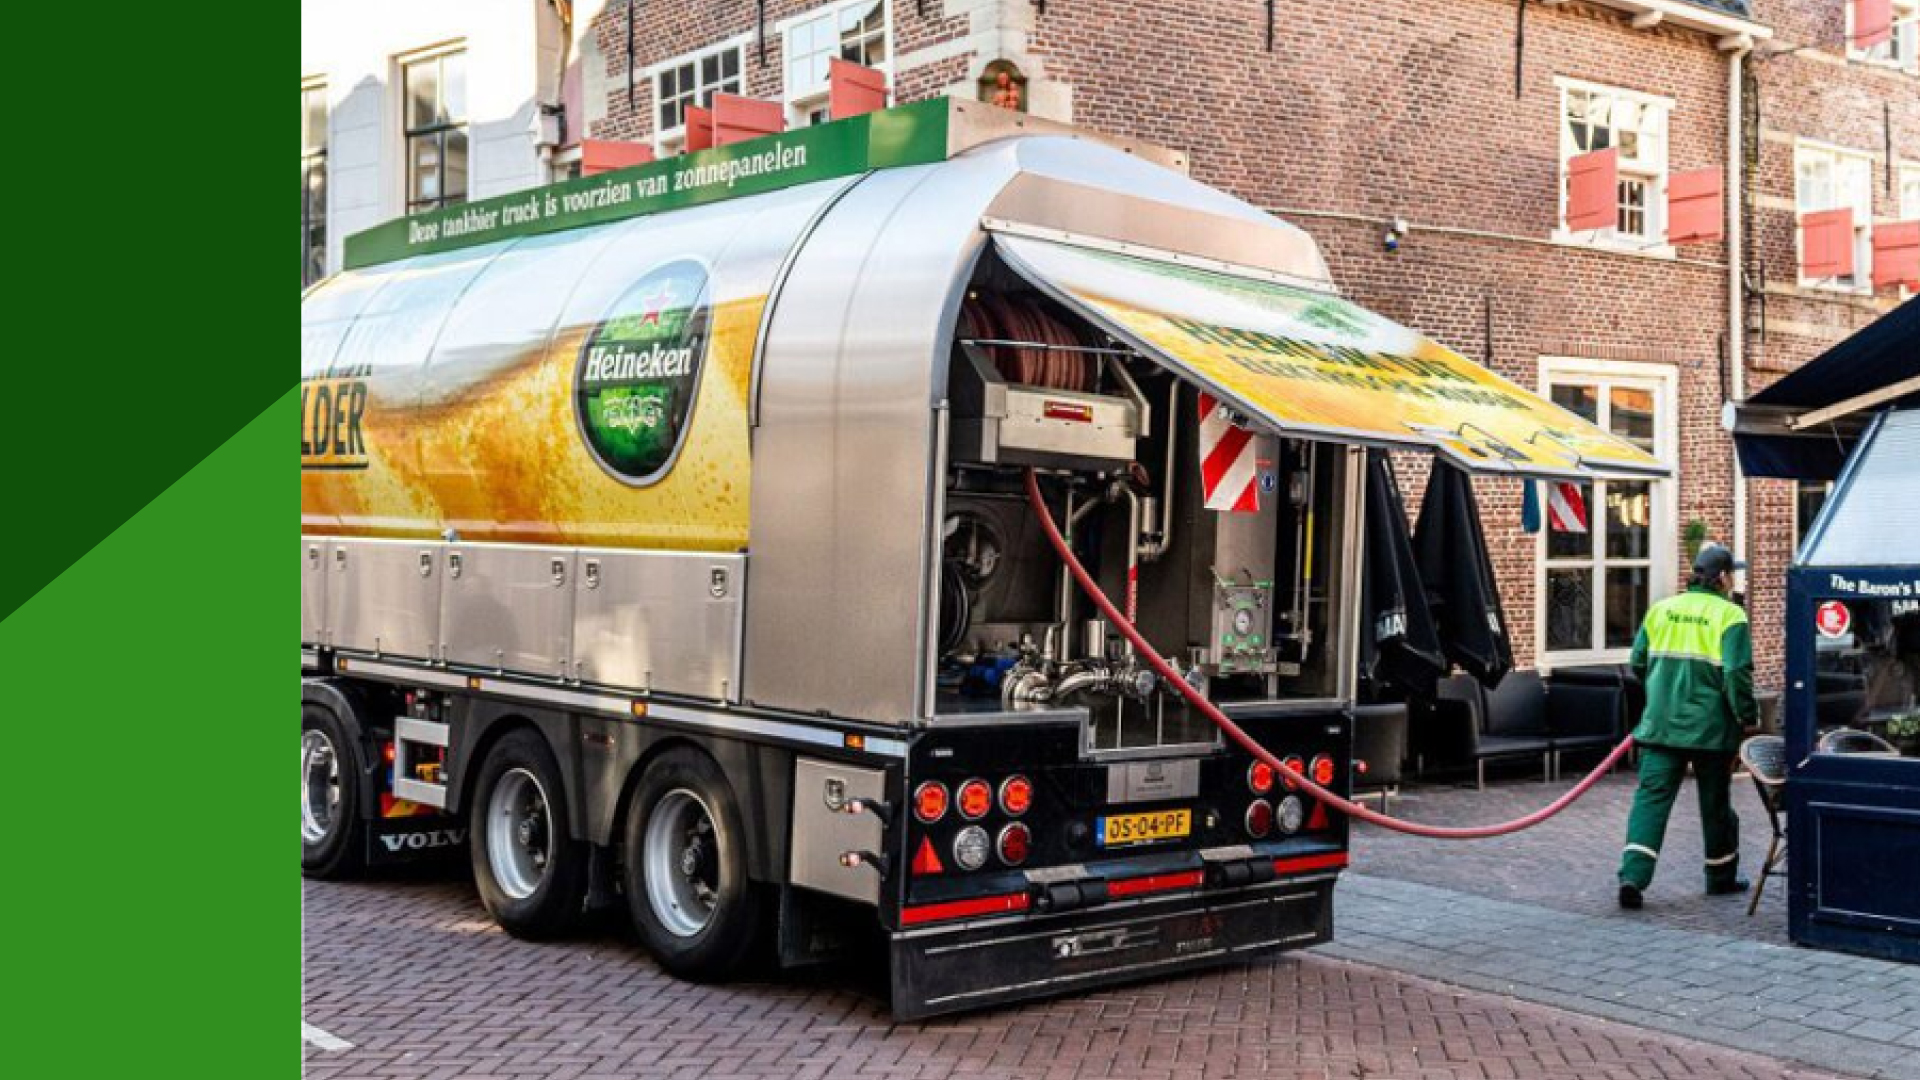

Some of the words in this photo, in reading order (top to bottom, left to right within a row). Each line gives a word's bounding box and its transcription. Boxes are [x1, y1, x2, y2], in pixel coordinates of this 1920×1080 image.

[409, 220, 438, 244] Deze
[442, 206, 499, 238] tankbier
[502, 194, 540, 226] truck
[545, 192, 557, 217] is
[562, 180, 632, 213] voorzien
[637, 174, 668, 198] van
[673, 141, 807, 188] zonnepanelen
[584, 343, 691, 381] Heineken
[1829, 574, 1855, 591] The
[1858, 580, 1912, 596] Baron's
